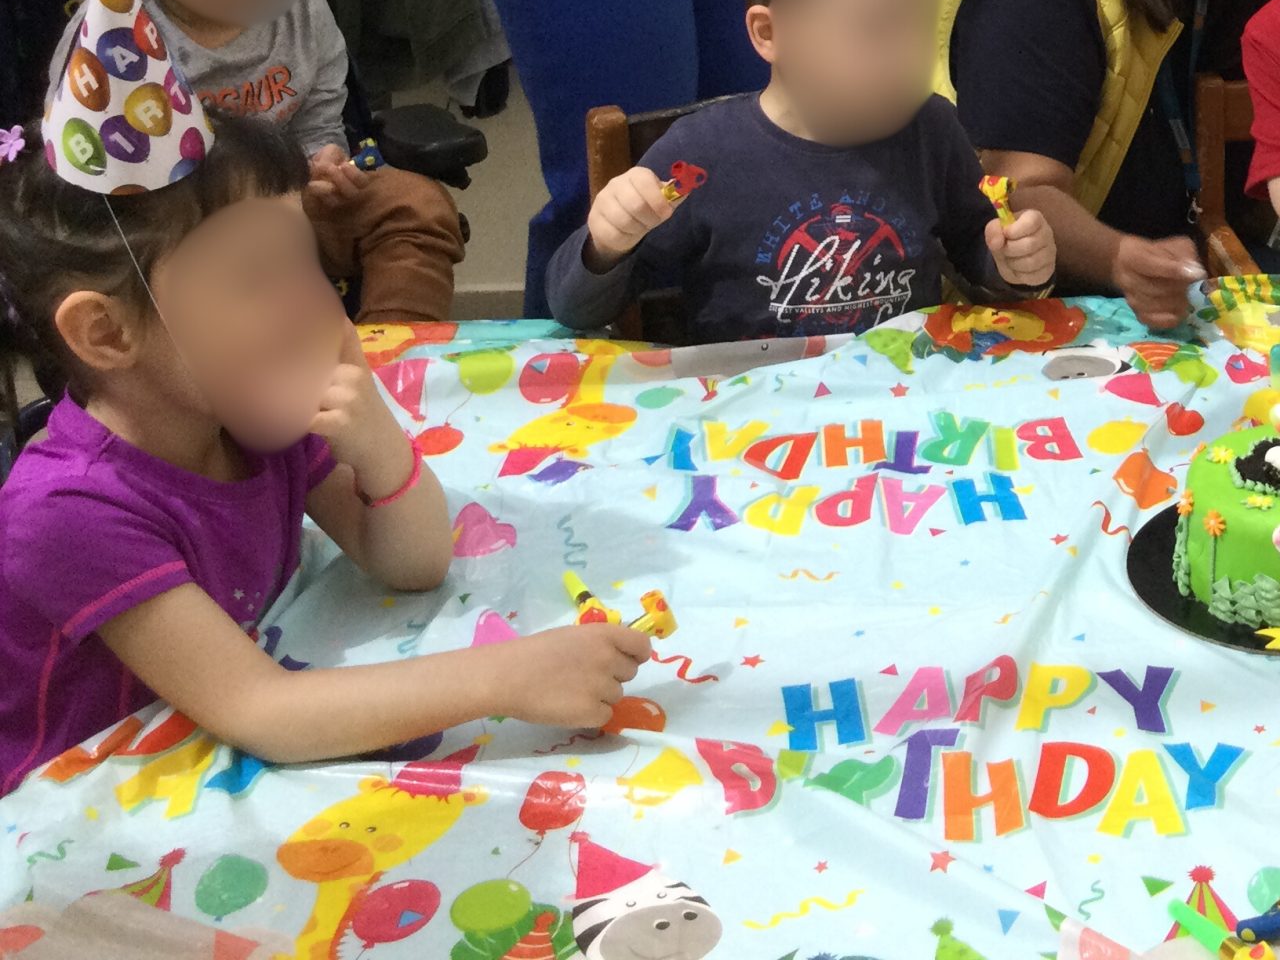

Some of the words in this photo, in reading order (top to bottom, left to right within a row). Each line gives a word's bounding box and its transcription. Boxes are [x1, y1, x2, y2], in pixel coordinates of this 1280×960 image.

[756, 235, 916, 327] Hiking
[664, 472, 1029, 536] HAPPY
[781, 654, 1174, 751] HAPPY
